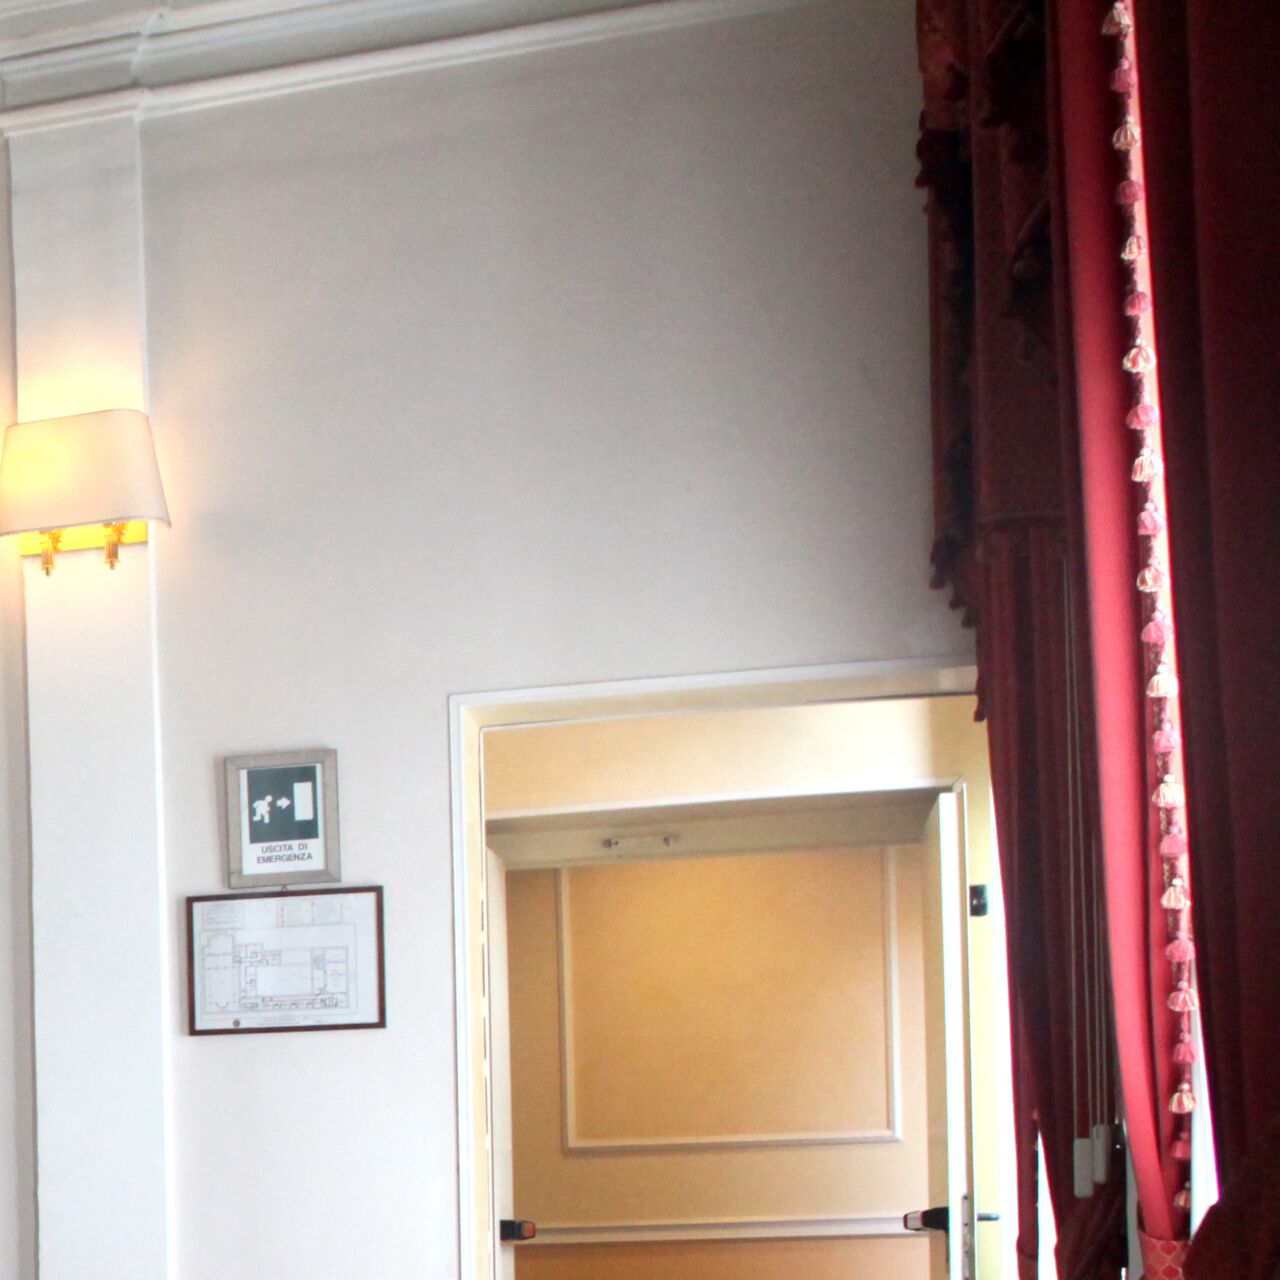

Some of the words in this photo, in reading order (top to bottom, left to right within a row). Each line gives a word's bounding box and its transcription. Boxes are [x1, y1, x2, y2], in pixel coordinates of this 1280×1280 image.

[261, 843, 293, 854] USCITA
[298, 842, 308, 851] DI
[256, 852, 313, 864] EMERGENZA
